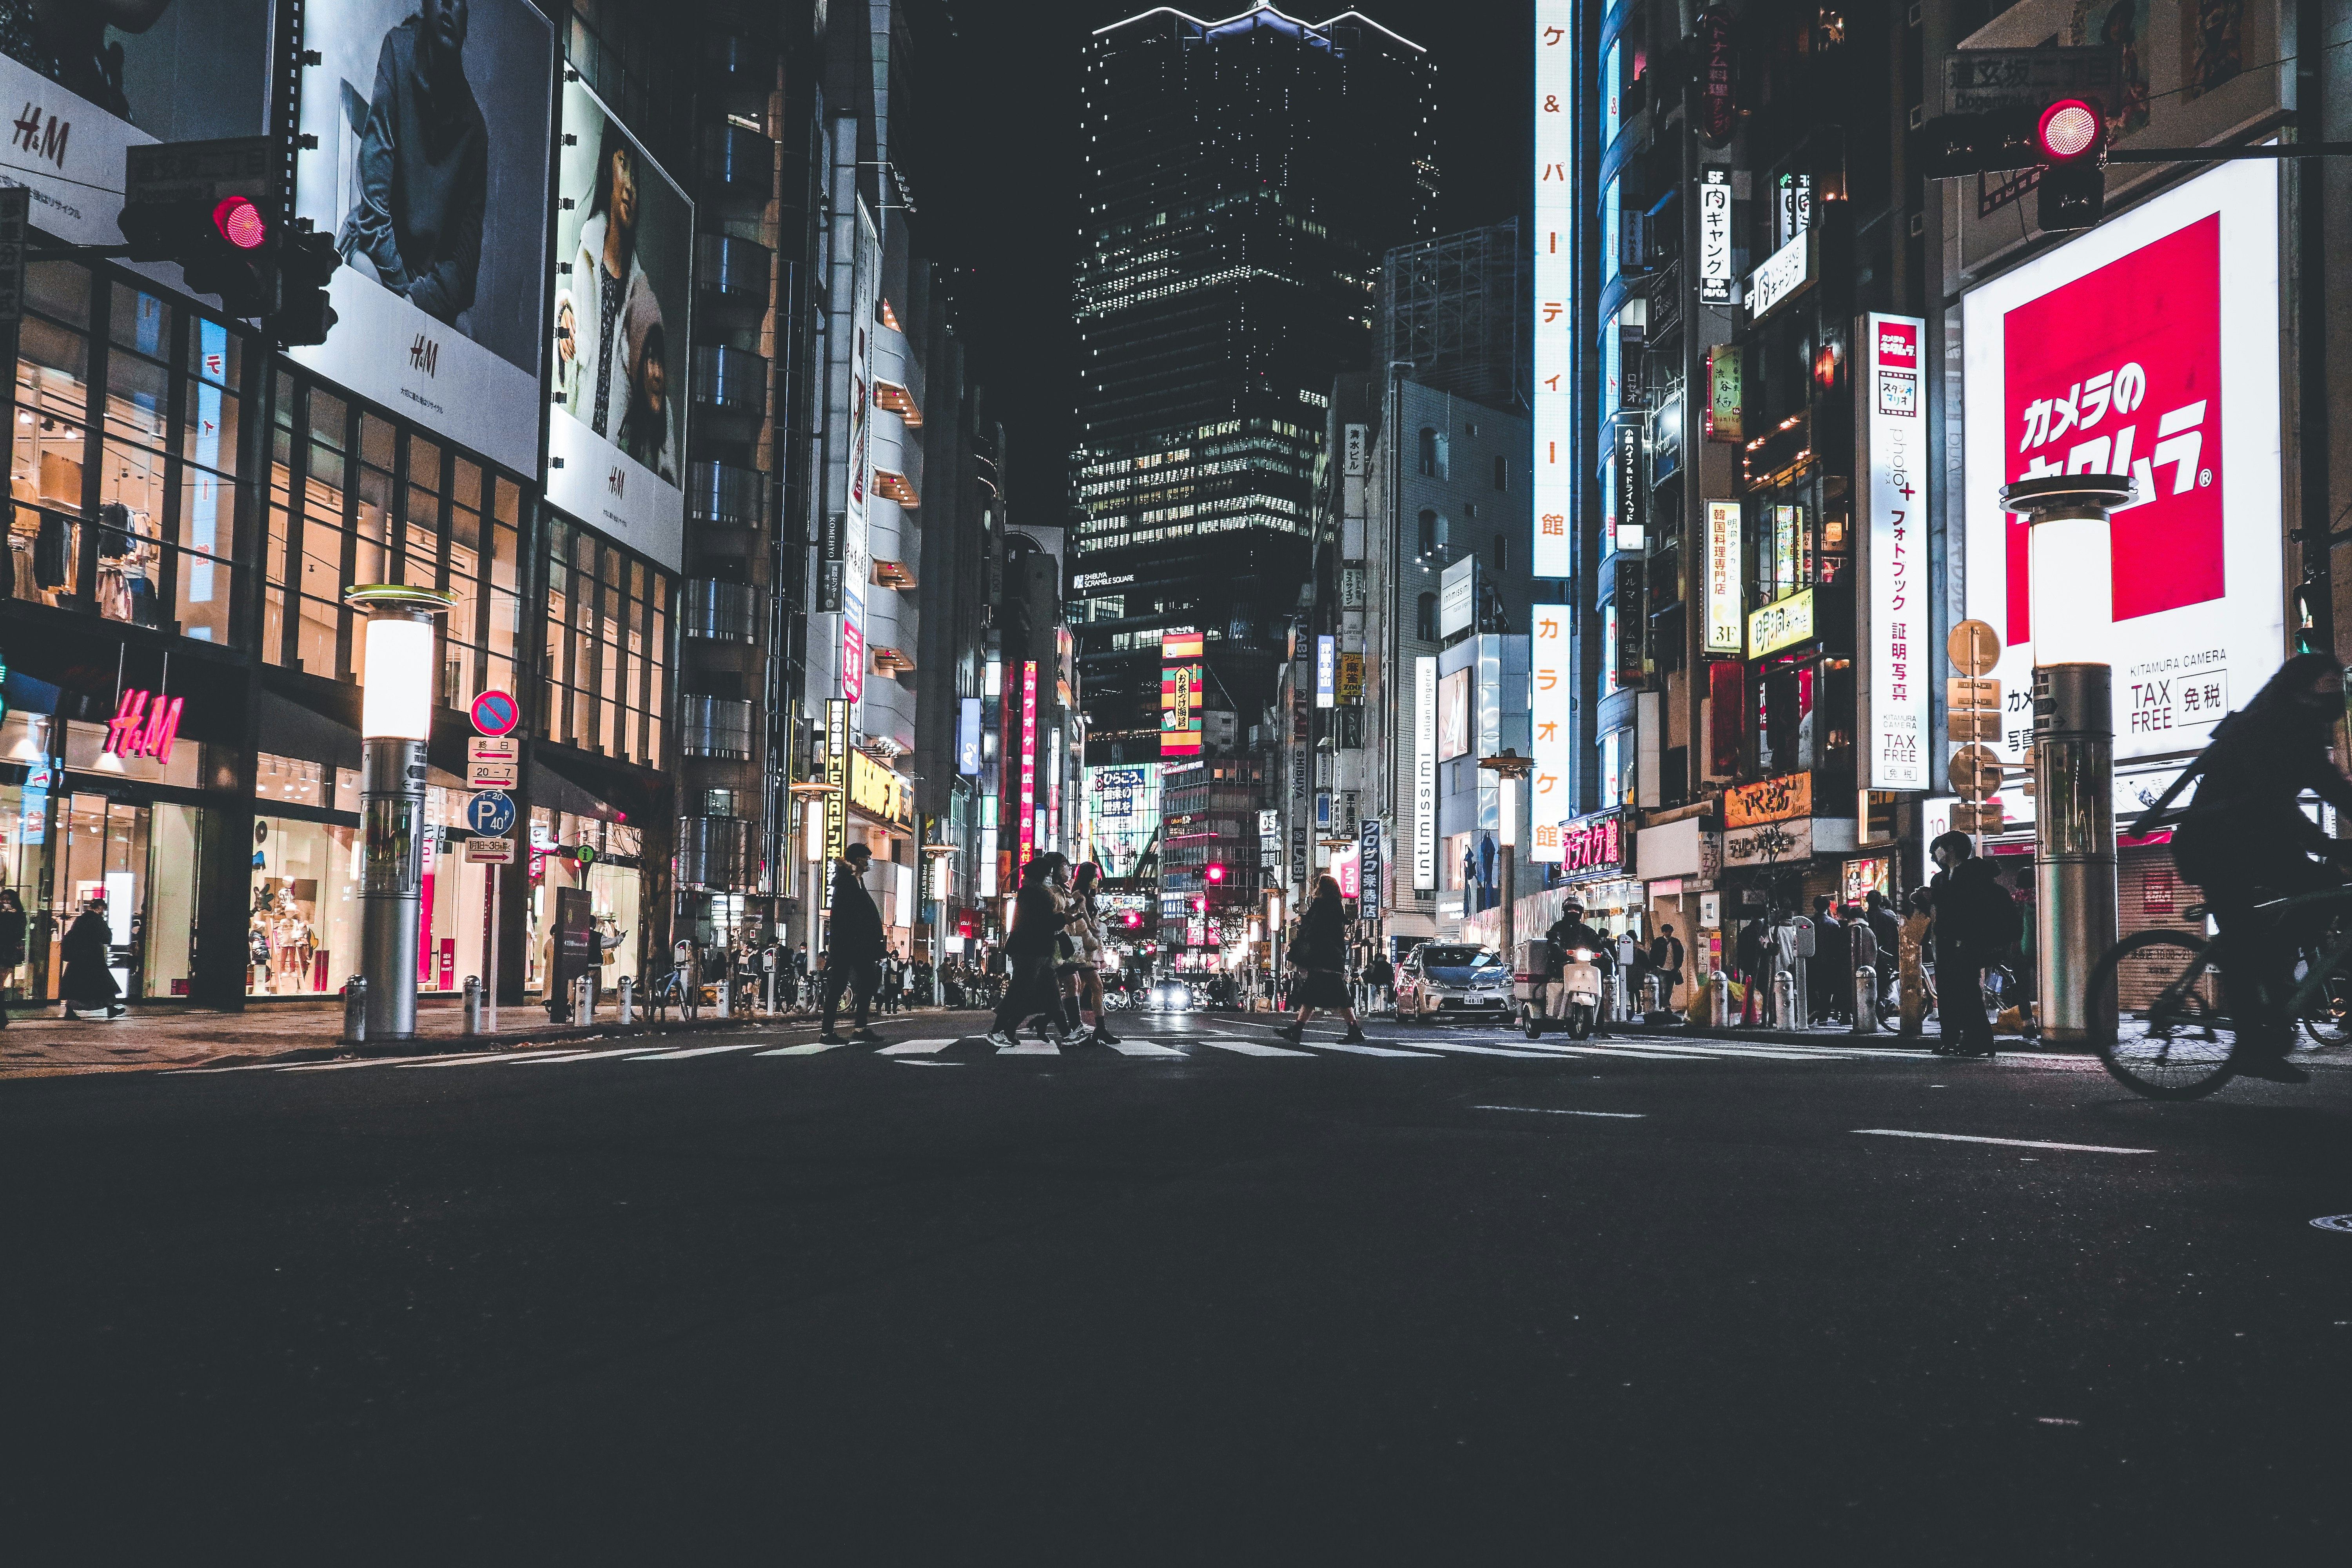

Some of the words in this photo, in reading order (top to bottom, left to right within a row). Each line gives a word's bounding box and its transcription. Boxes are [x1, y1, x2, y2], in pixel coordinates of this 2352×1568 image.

[1951, 58, 2110, 89] 道玄坂二丁目
[13, 102, 70, 170] H&M
[1708, 171, 1723, 183] 5F
[1706, 189, 1725, 276] 肉ギャング
[1744, 289, 1754, 310] 5F
[1880, 342, 1915, 356] キタムラ
[1881, 334, 1906, 343] カメラの
[410, 334, 438, 379] H&M
[1627, 374, 1637, 403] ロゼオ
[1883, 383, 1913, 396] スタジオ
[1887, 394, 1907, 406] マリオ
[2020, 363, 2146, 453] カメラの
[608, 465, 625, 500] H&M
[1624, 429, 1634, 523] 小顔ハイフ&ドライヘッド
[1714, 509, 1726, 595] 韓国料理専門店
[1892, 510, 1906, 610] フォトブック
[1085, 572, 1107, 580] SHIBUYA
[1085, 578, 1112, 588] SCRAMBLE
[1112, 575, 1134, 584] SQUARE
[1444, 583, 1469, 604] intimissimi
[1297, 624, 1307, 658] LABI
[1717, 626, 1737, 642] 3F
[1756, 608, 1785, 652] 明洞
[1346, 662, 1359, 684] 麻雀
[1892, 623, 1907, 701] 証明写真
[2131, 660, 2180, 677] KITAMURA
[2183, 649, 2226, 667] CAMERA
[1423, 668, 1432, 704] lingerie
[2131, 679, 2171, 709] TAX
[2185, 683, 2221, 712] 免税
[1178, 674, 1187, 727] お茶づけ海苔
[106, 688, 184, 764] H&M
[1423, 706, 1431, 740] Italian
[1536, 618, 1558, 848] カラオケ館
[2132, 707, 2172, 733] FREE
[479, 740, 509, 750] 終日
[963, 742, 977, 767] A2
[1884, 734, 1916, 749] TAX
[2008, 729, 2033, 752] 写真
[1884, 749, 1916, 762] FREE
[477, 768, 489, 776] 20
[505, 768, 511, 777] 7
[1103, 771, 1143, 785] ひらこう、
[1296, 750, 1305, 799] SHIBUYA
[1890, 769, 1912, 779] 免税
[477, 801, 497, 829] P
[1261, 816, 1276, 829] OS
[1419, 753, 1432, 877] intimissimi
[926, 830, 935, 859] SMC
[1021, 842, 1031, 862] 受付
[1561, 819, 1617, 871] カラオケ館
[1294, 845, 1304, 879] LABI
[1363, 822, 1379, 918] クロサワ楽器店
[1345, 867, 1355, 893] アコム
[1163, 902, 1176, 913] AGA
